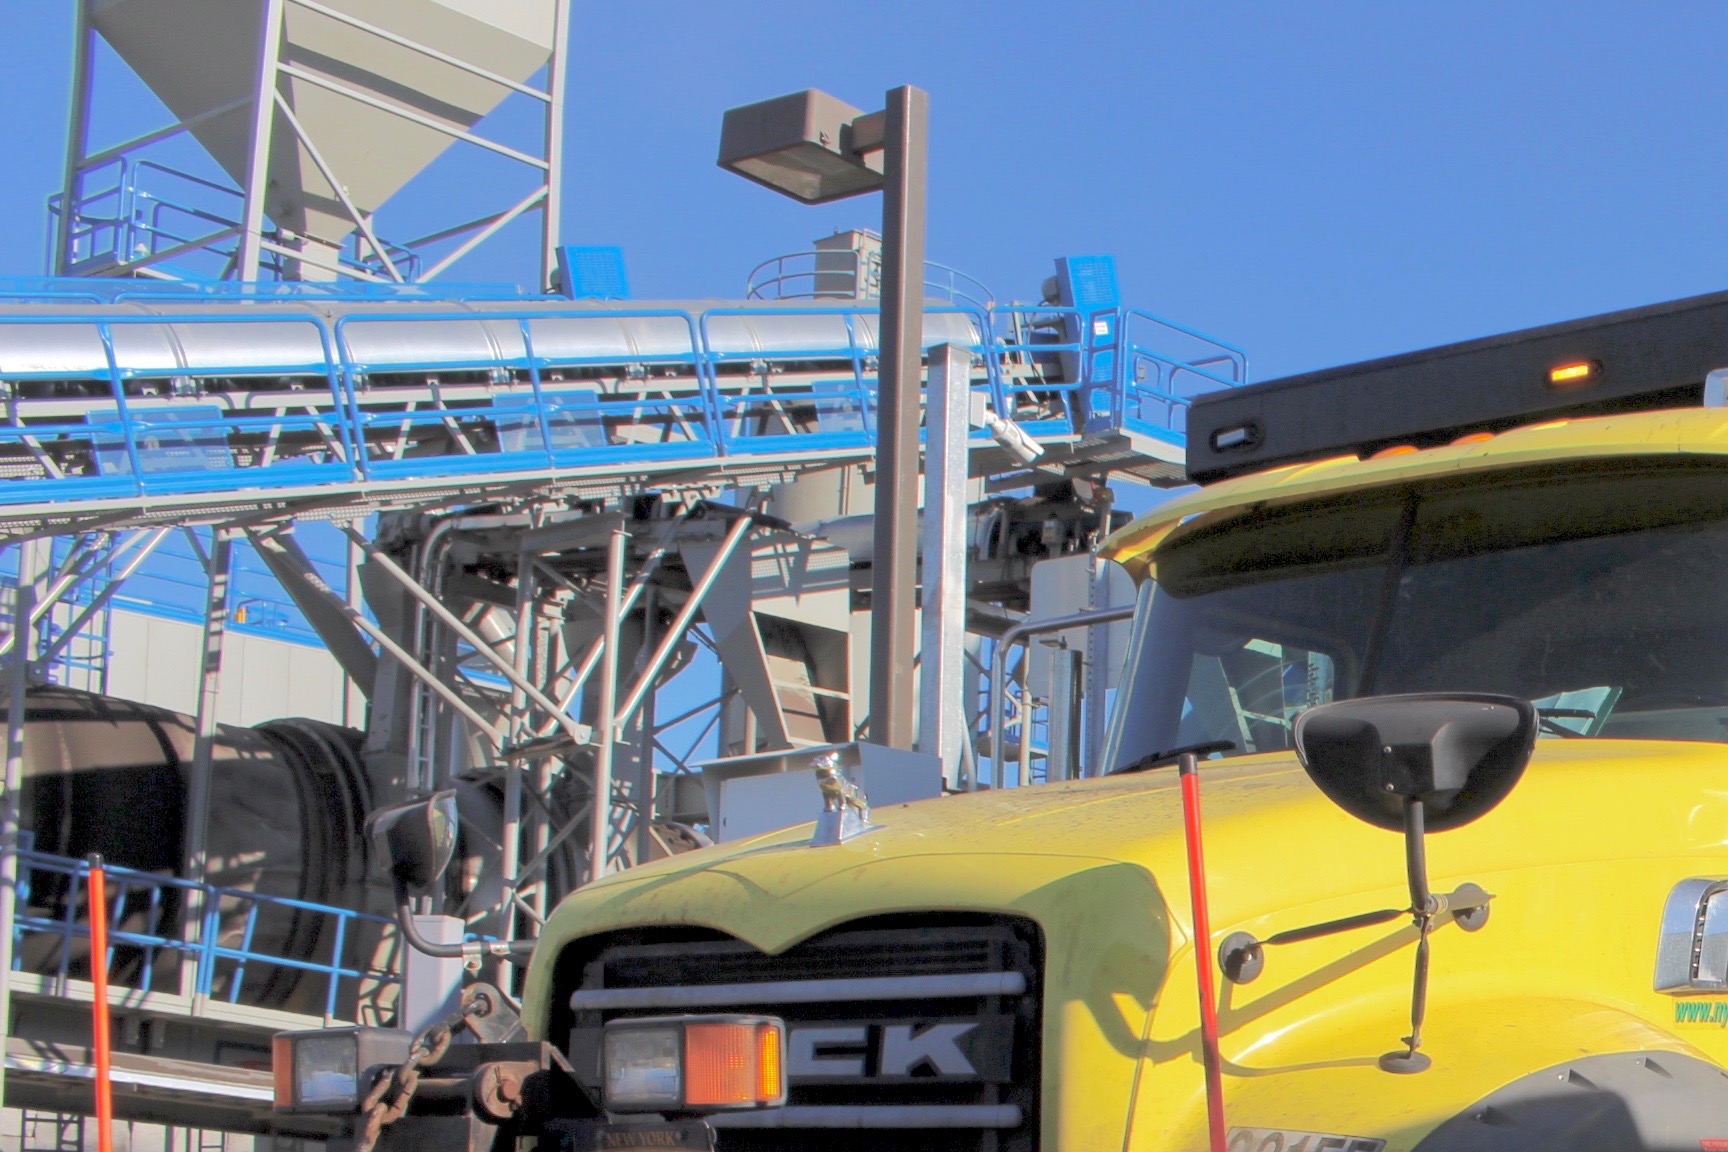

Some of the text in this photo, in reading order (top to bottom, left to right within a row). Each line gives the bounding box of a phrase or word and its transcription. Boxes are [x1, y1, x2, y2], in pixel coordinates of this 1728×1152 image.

[788, 1023, 980, 1075] CK
[606, 1131, 676, 1147] NEW YORK
